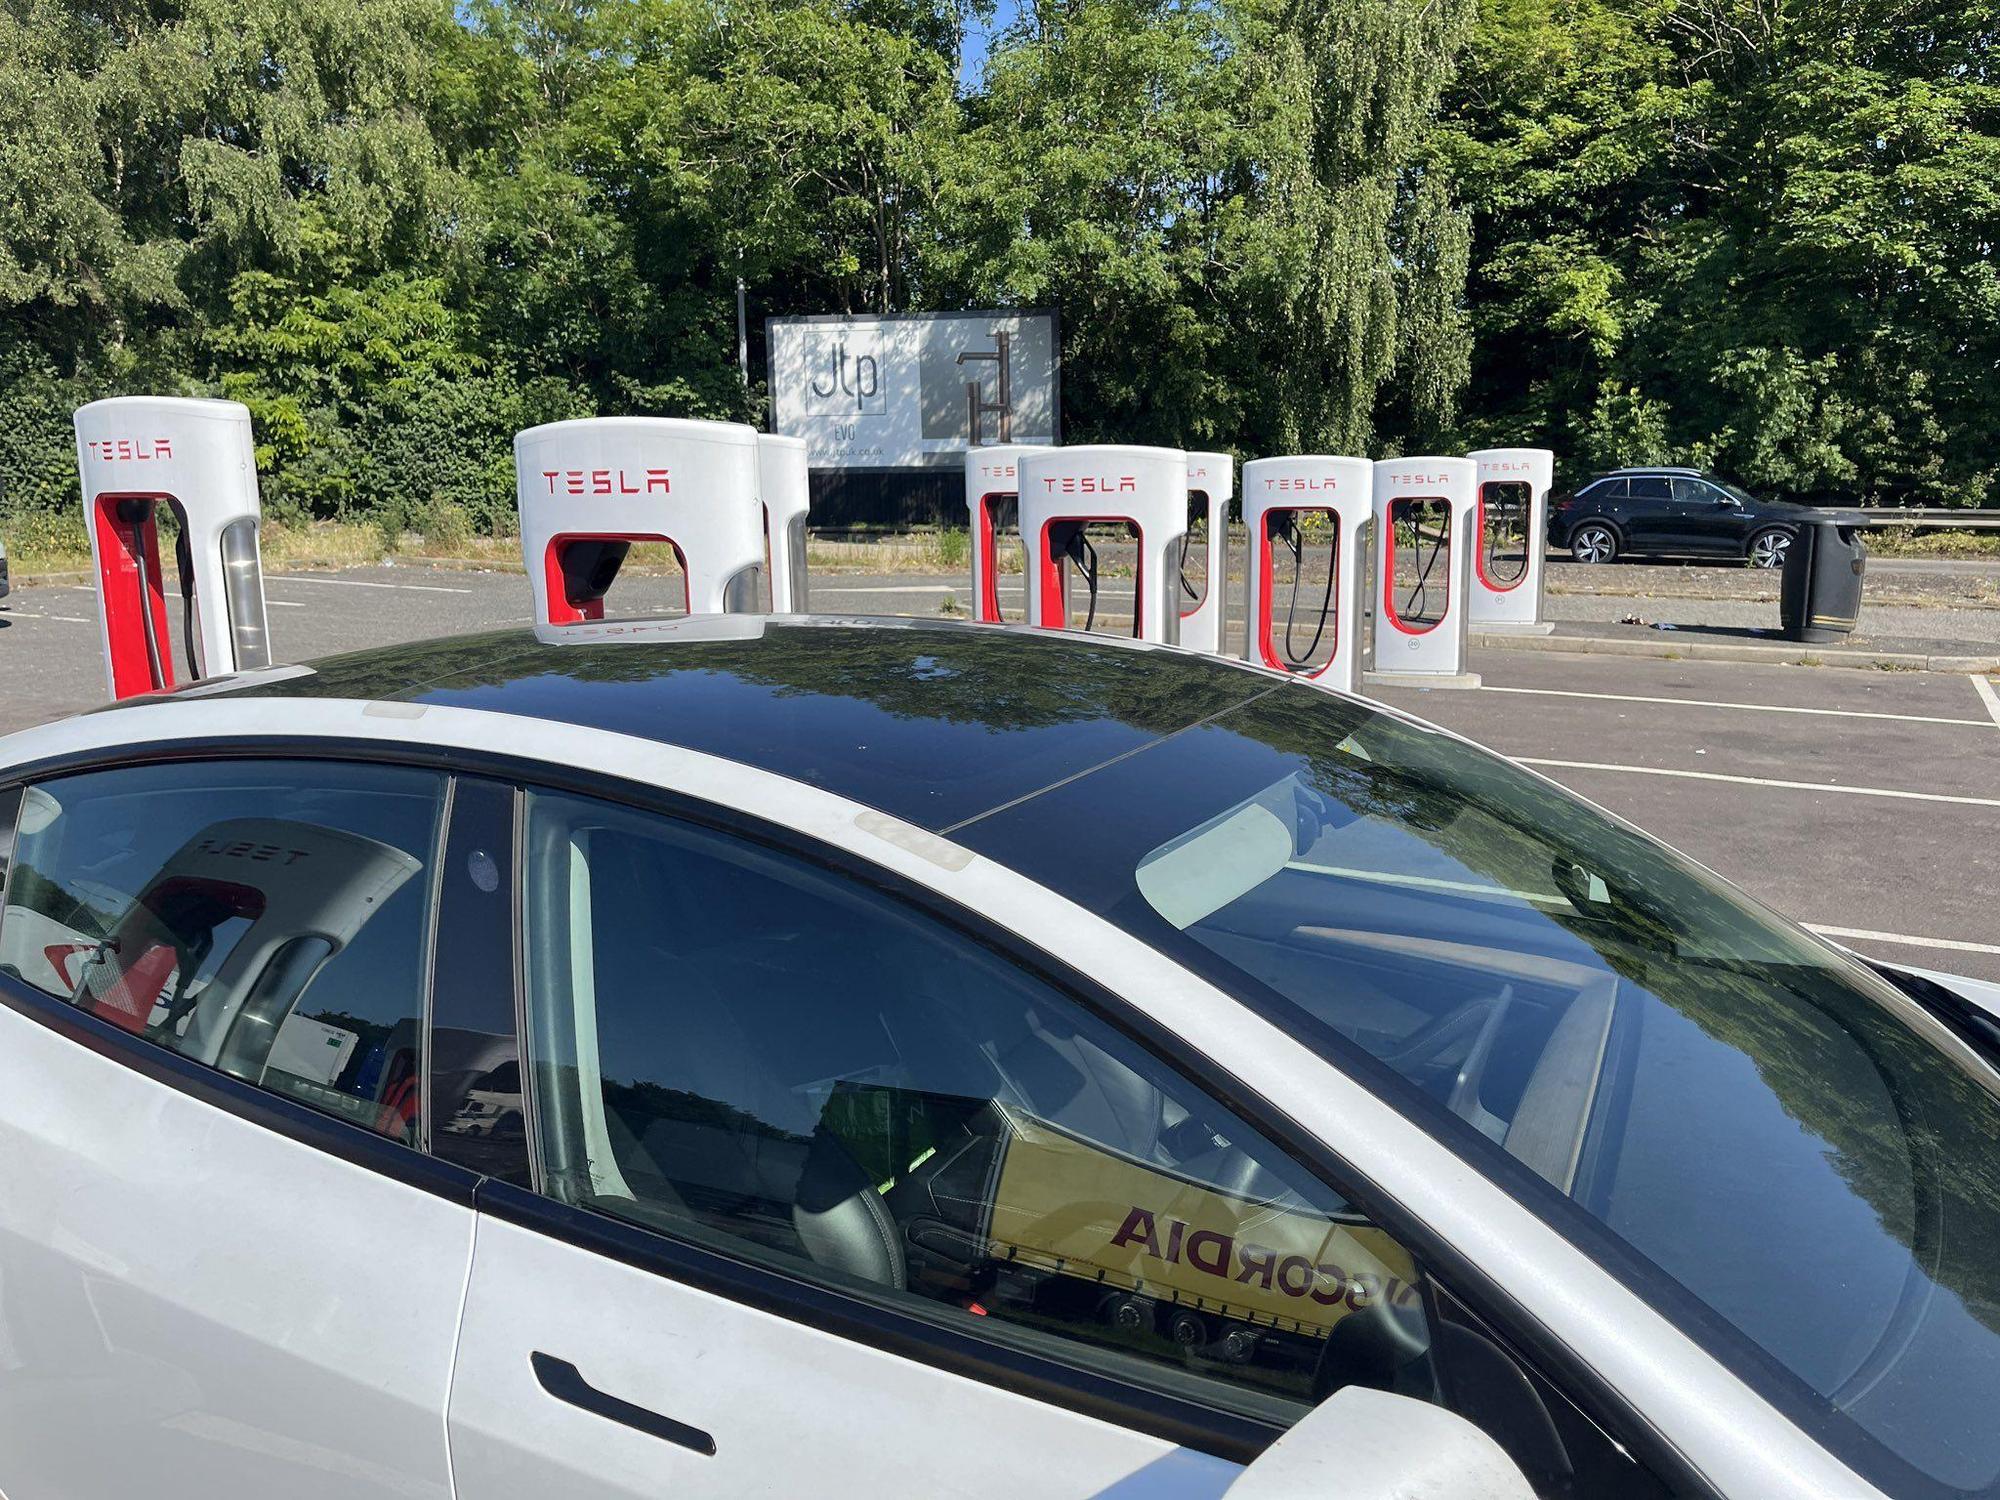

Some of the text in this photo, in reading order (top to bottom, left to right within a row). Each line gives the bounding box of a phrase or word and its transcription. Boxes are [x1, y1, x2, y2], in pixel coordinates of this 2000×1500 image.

[834, 423, 855, 441] EVO
[88, 439, 172, 460] TESLA
[982, 466, 1016, 477] TES
[1480, 462, 1531, 471] TESLA
[542, 469, 670, 494] TESLA
[1043, 476, 1136, 493] TESLA
[1264, 477, 1336, 490] TESLA
[1390, 473, 1449, 484] TESLA
